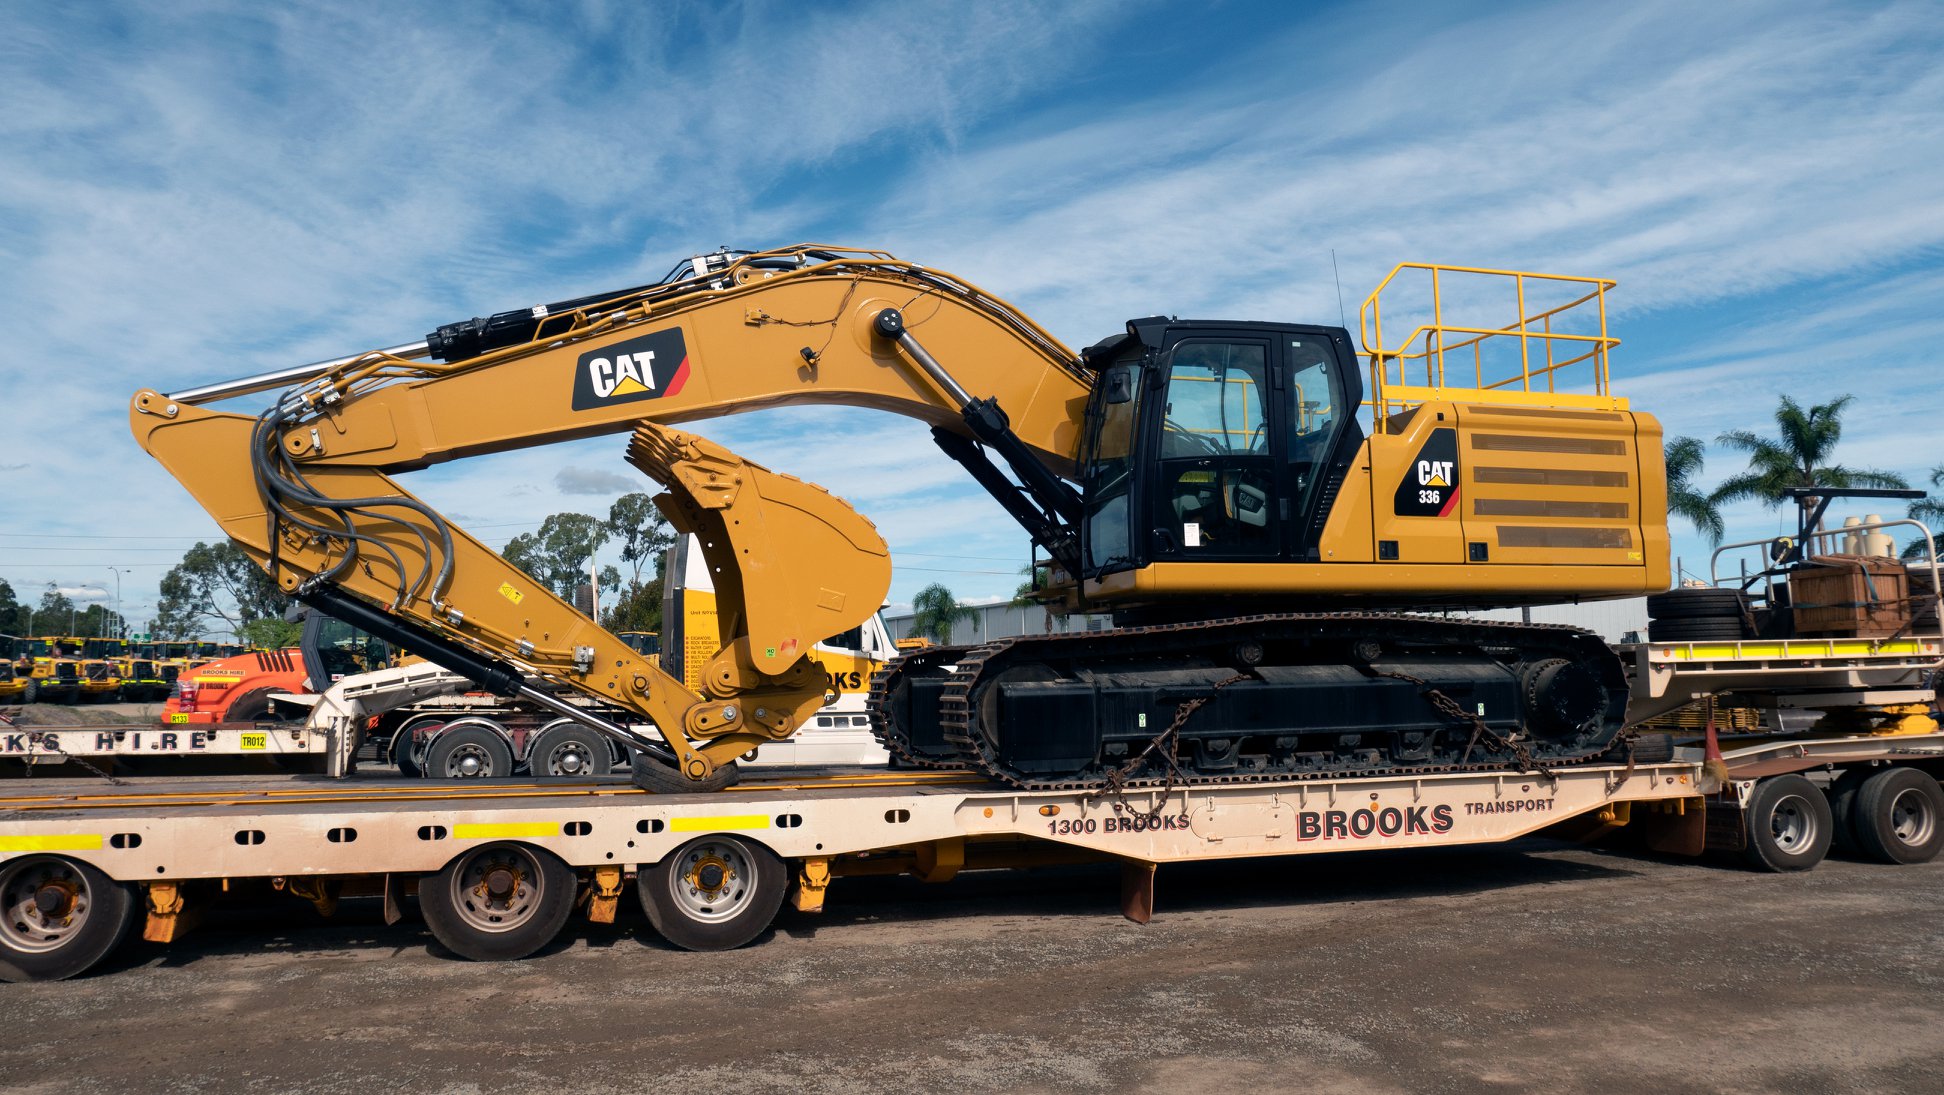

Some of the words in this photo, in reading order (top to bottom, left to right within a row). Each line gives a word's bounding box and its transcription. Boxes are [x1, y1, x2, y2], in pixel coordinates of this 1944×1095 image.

[589, 350, 656, 398] CAT
[1418, 460, 1453, 486] CAT
[1418, 490, 1440, 504] 336
[172, 715, 188, 723] R133
[95, 732, 207, 751] HIRE
[242, 736, 265, 747] TR012
[1048, 819, 1097, 835] 1300
[1104, 814, 1190, 834] BROOKS
[1297, 804, 1454, 842] BROOKS
[1465, 798, 1555, 816] TRANSPORT
